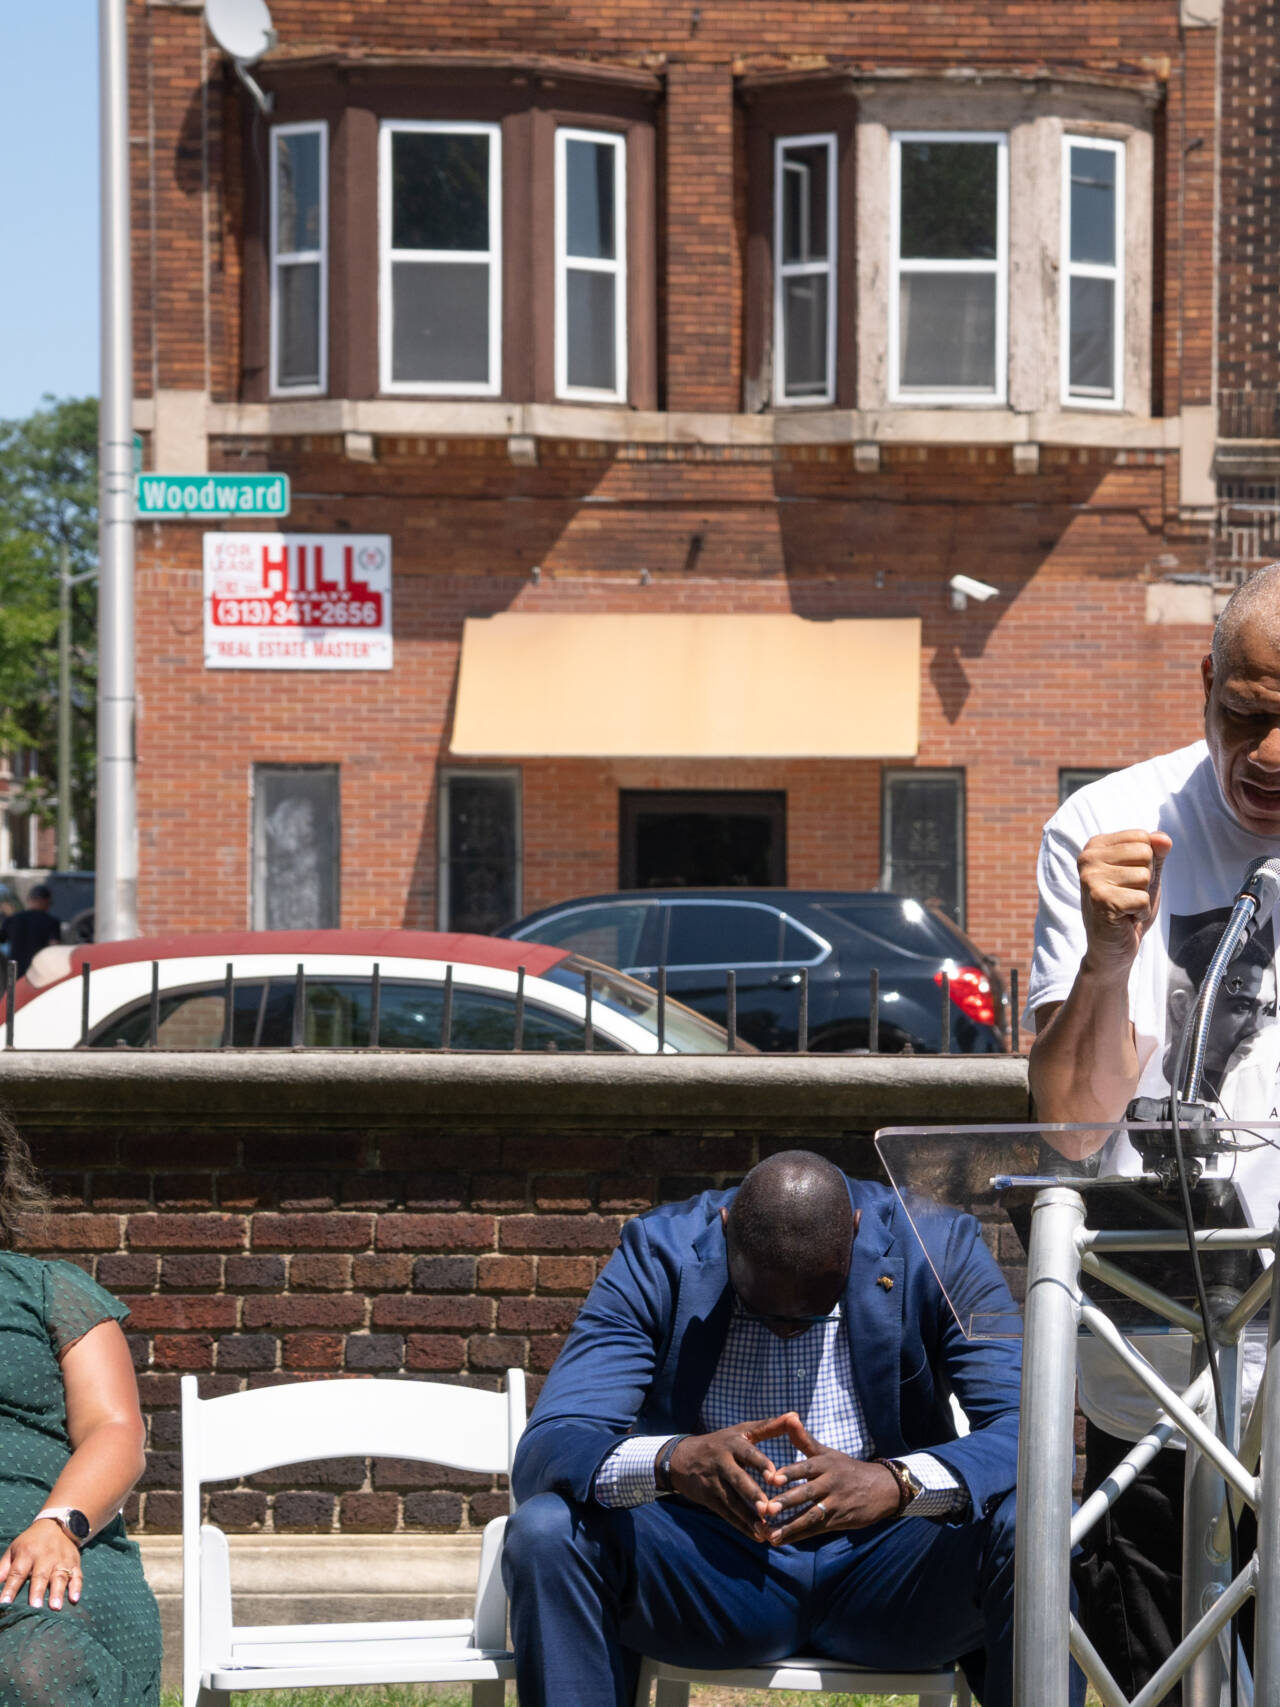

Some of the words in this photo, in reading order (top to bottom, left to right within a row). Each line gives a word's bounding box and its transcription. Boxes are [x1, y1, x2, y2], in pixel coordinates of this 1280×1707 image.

[141, 478, 283, 510] Woodward
[261, 545, 369, 592] HILL
[217, 600, 271, 625] (313)
[273, 600, 377, 625] 341-2656
[257, 641, 307, 658] ESTATE
